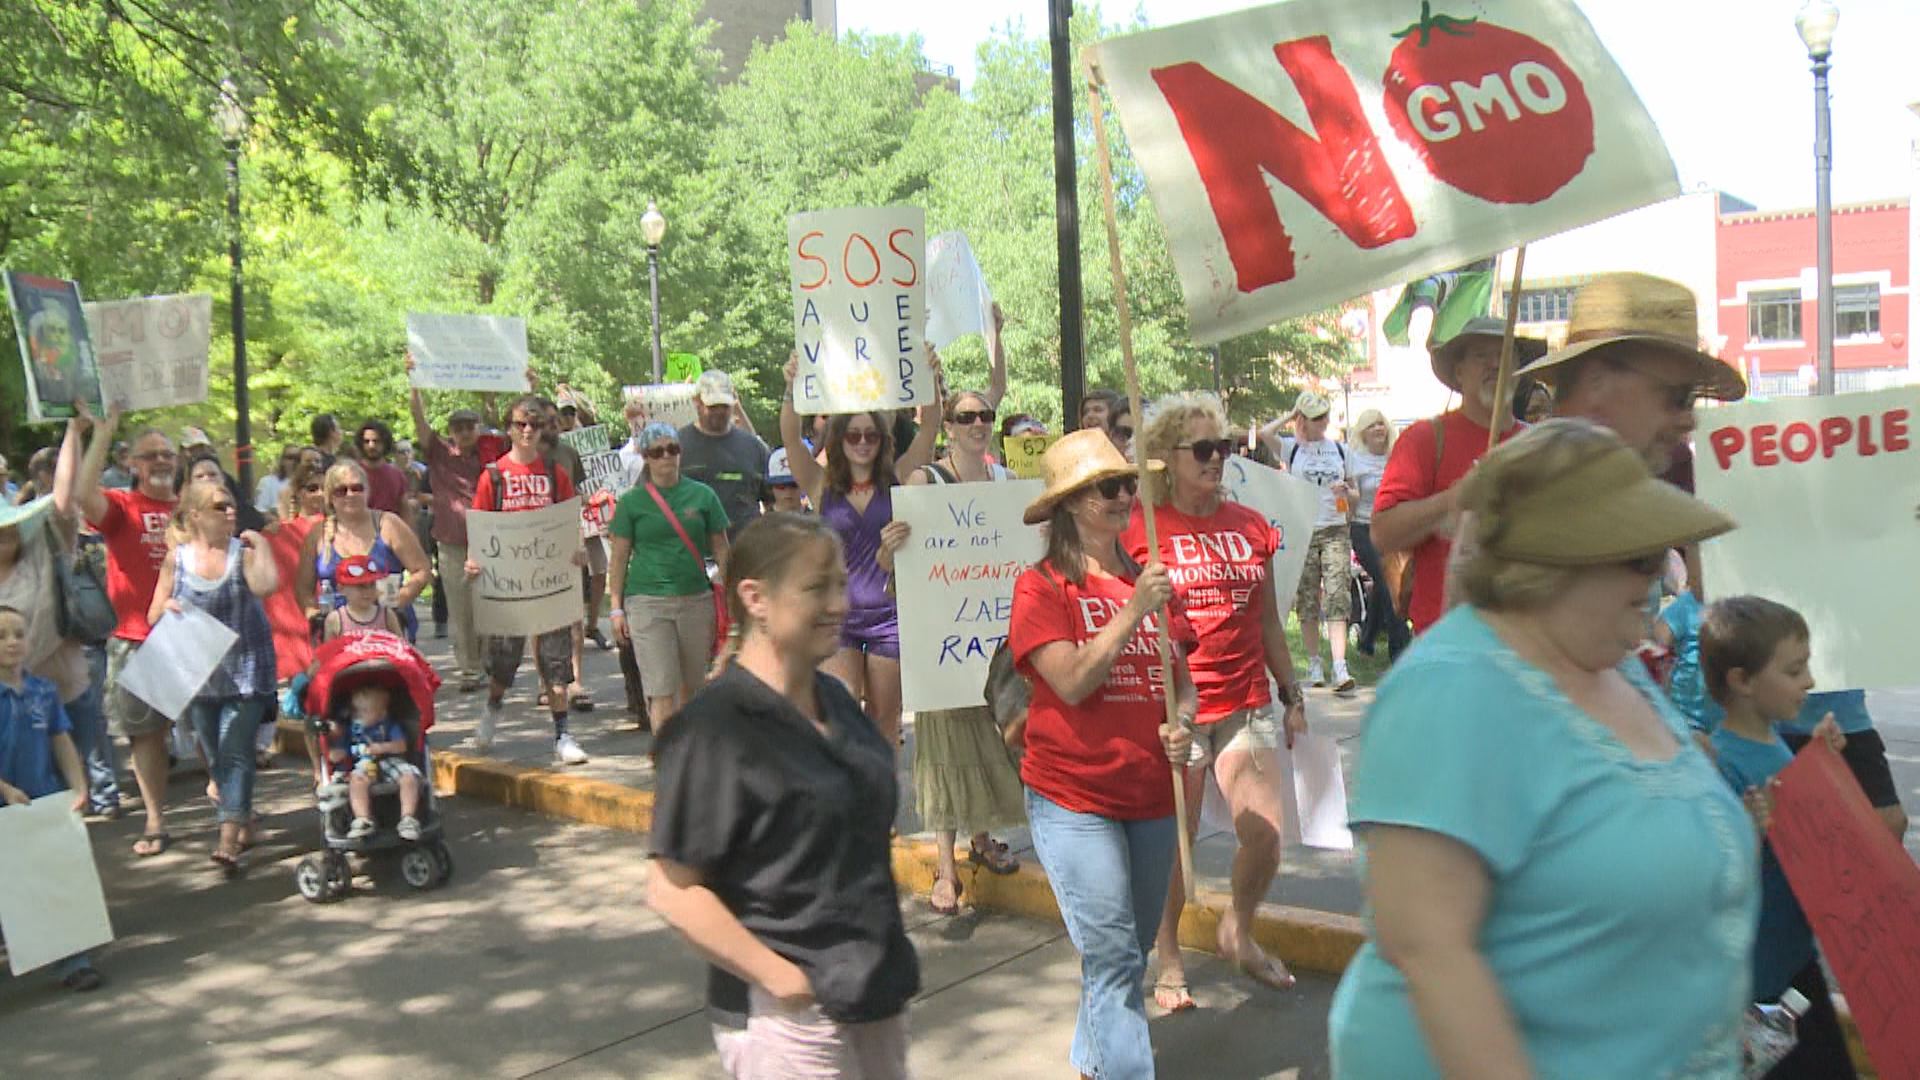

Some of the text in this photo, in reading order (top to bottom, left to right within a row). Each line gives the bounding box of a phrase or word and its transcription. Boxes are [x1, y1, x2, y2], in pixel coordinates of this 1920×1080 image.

[1406, 61, 1567, 143] GMO
[1709, 408, 1911, 471] PEOPLE
[502, 470, 550, 497] END
[948, 499, 988, 529] We
[481, 535, 562, 560] I vote
[924, 533, 1004, 550] are not
[1169, 530, 1254, 565] END
[530, 566, 570, 591] GMO
[1167, 564, 1265, 586] MONSANTO
